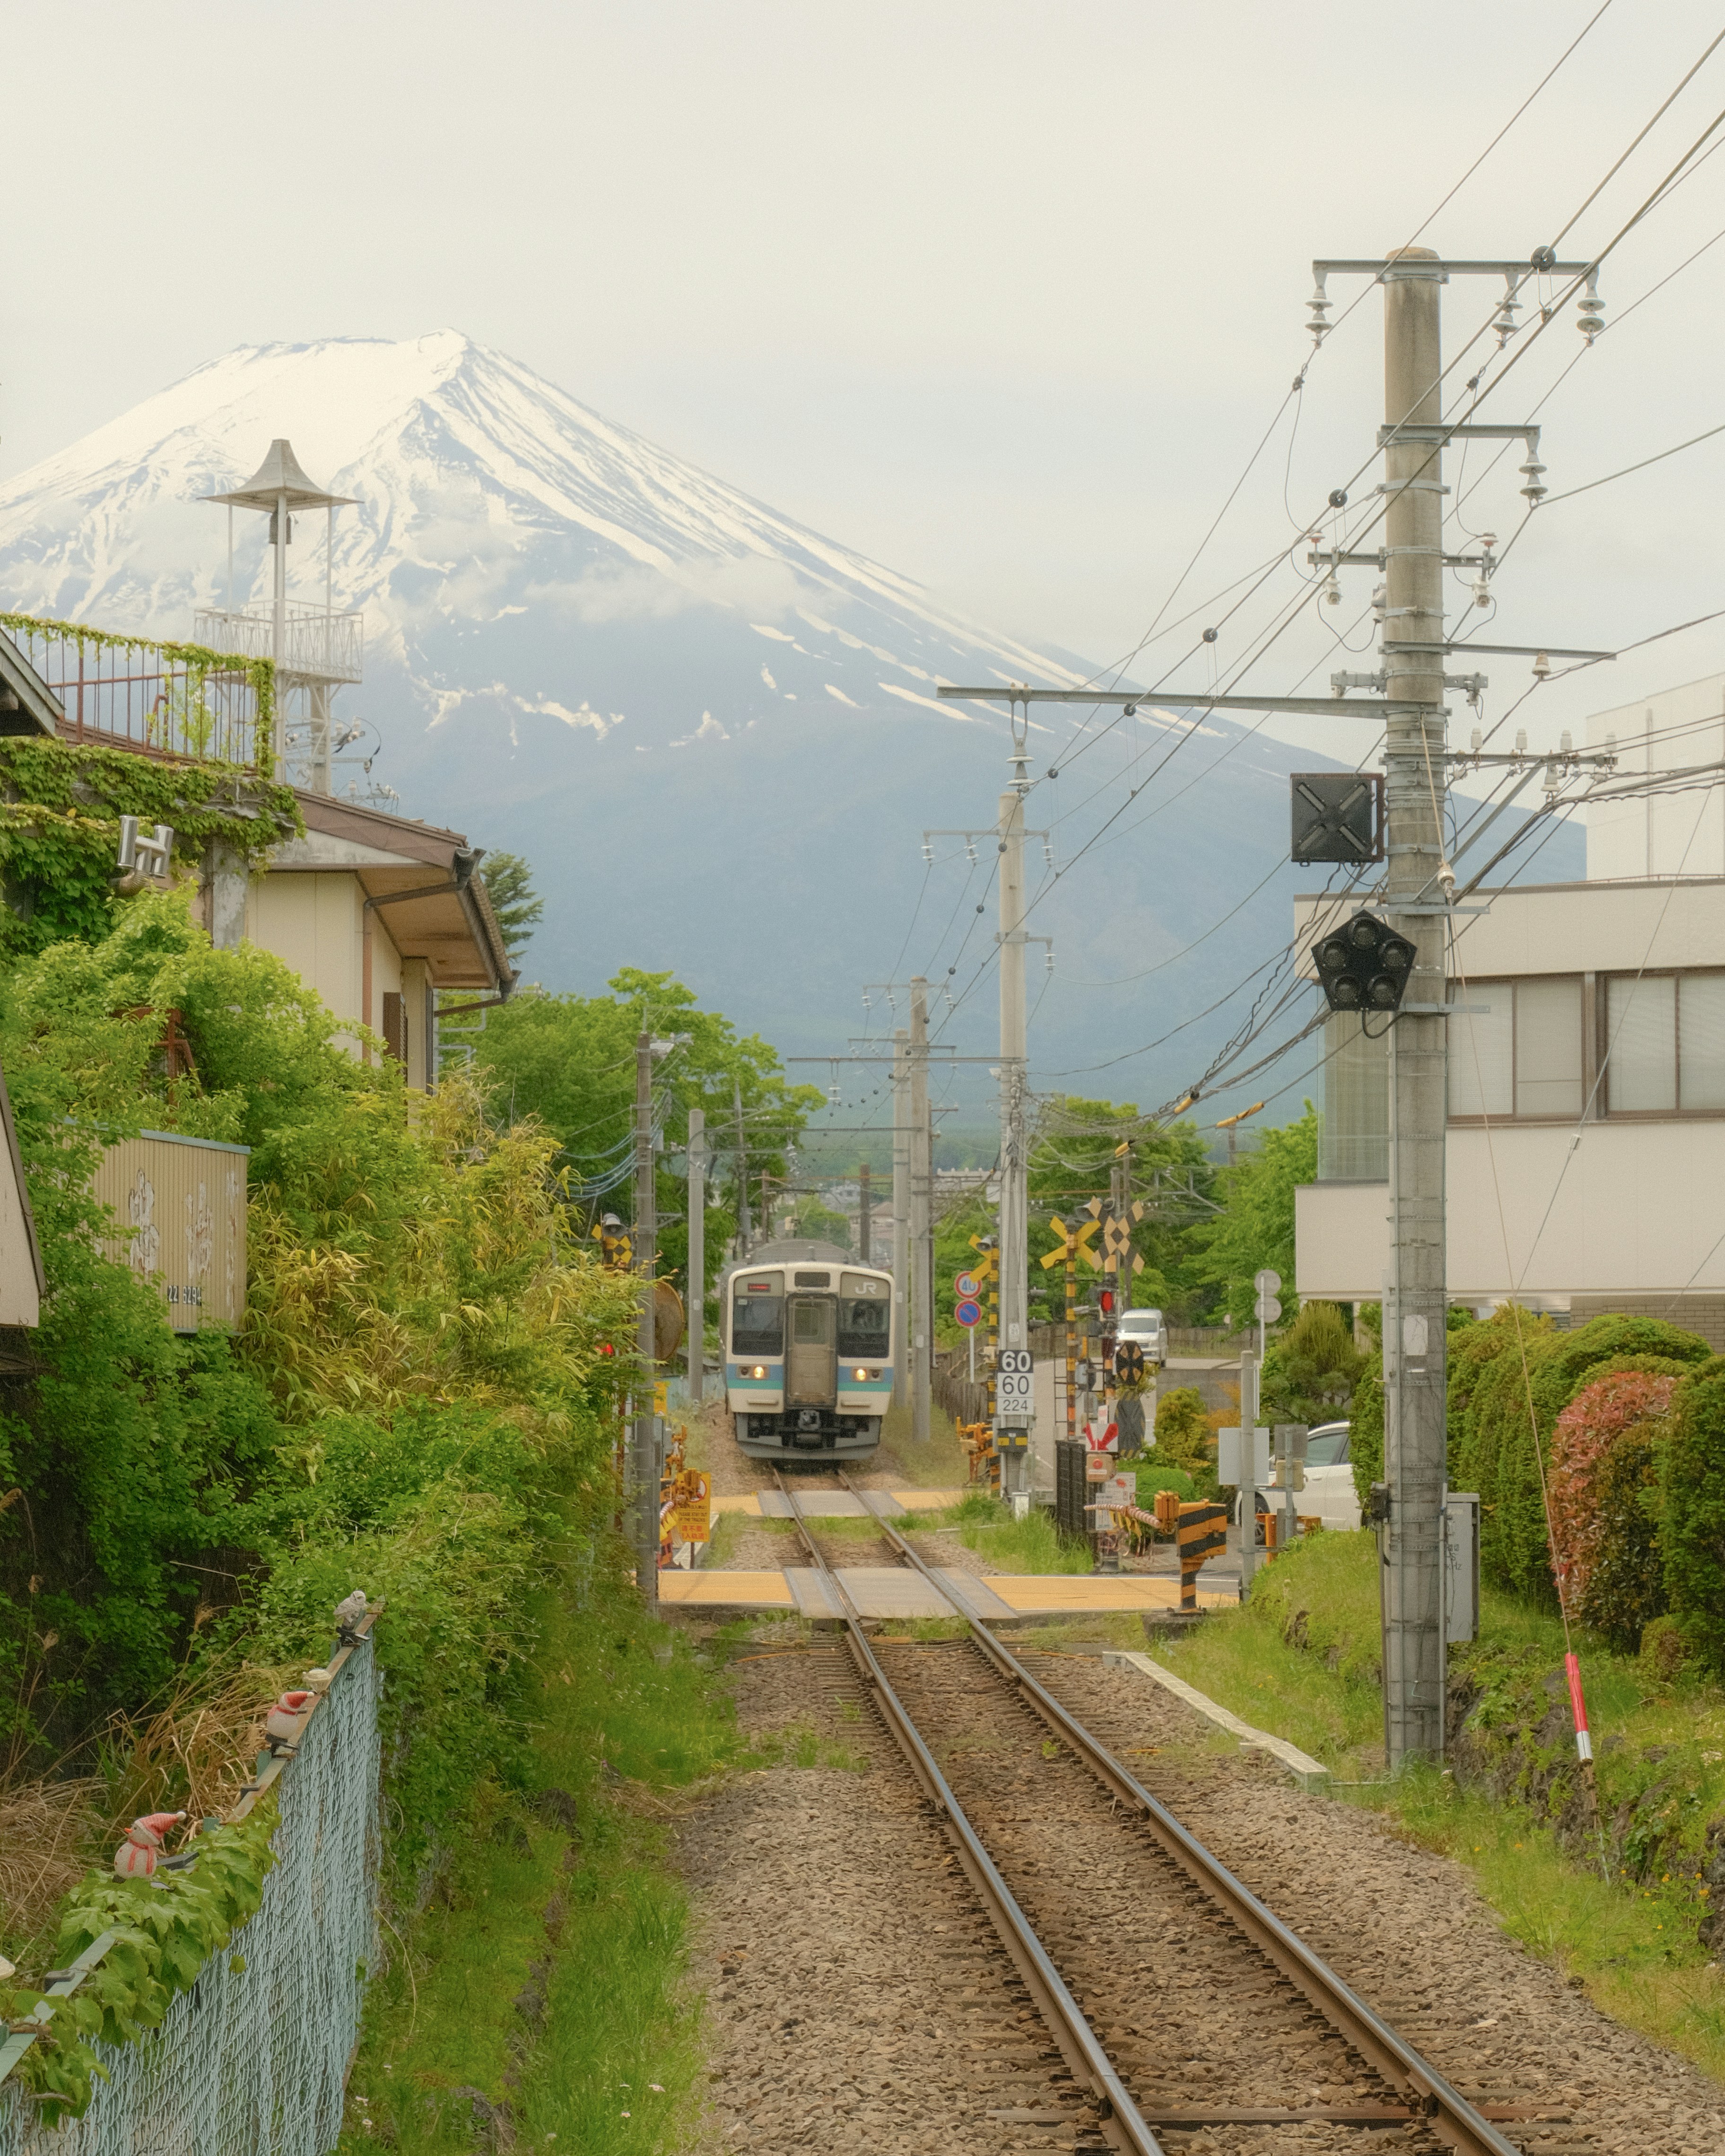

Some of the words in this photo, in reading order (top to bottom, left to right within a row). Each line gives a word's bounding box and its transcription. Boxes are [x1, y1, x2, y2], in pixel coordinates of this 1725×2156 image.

[855, 1282, 877, 1295] JR
[1002, 1351, 1031, 1372] 60
[1002, 1375, 1029, 1395] 60
[1003, 1400, 1028, 1411] 224
